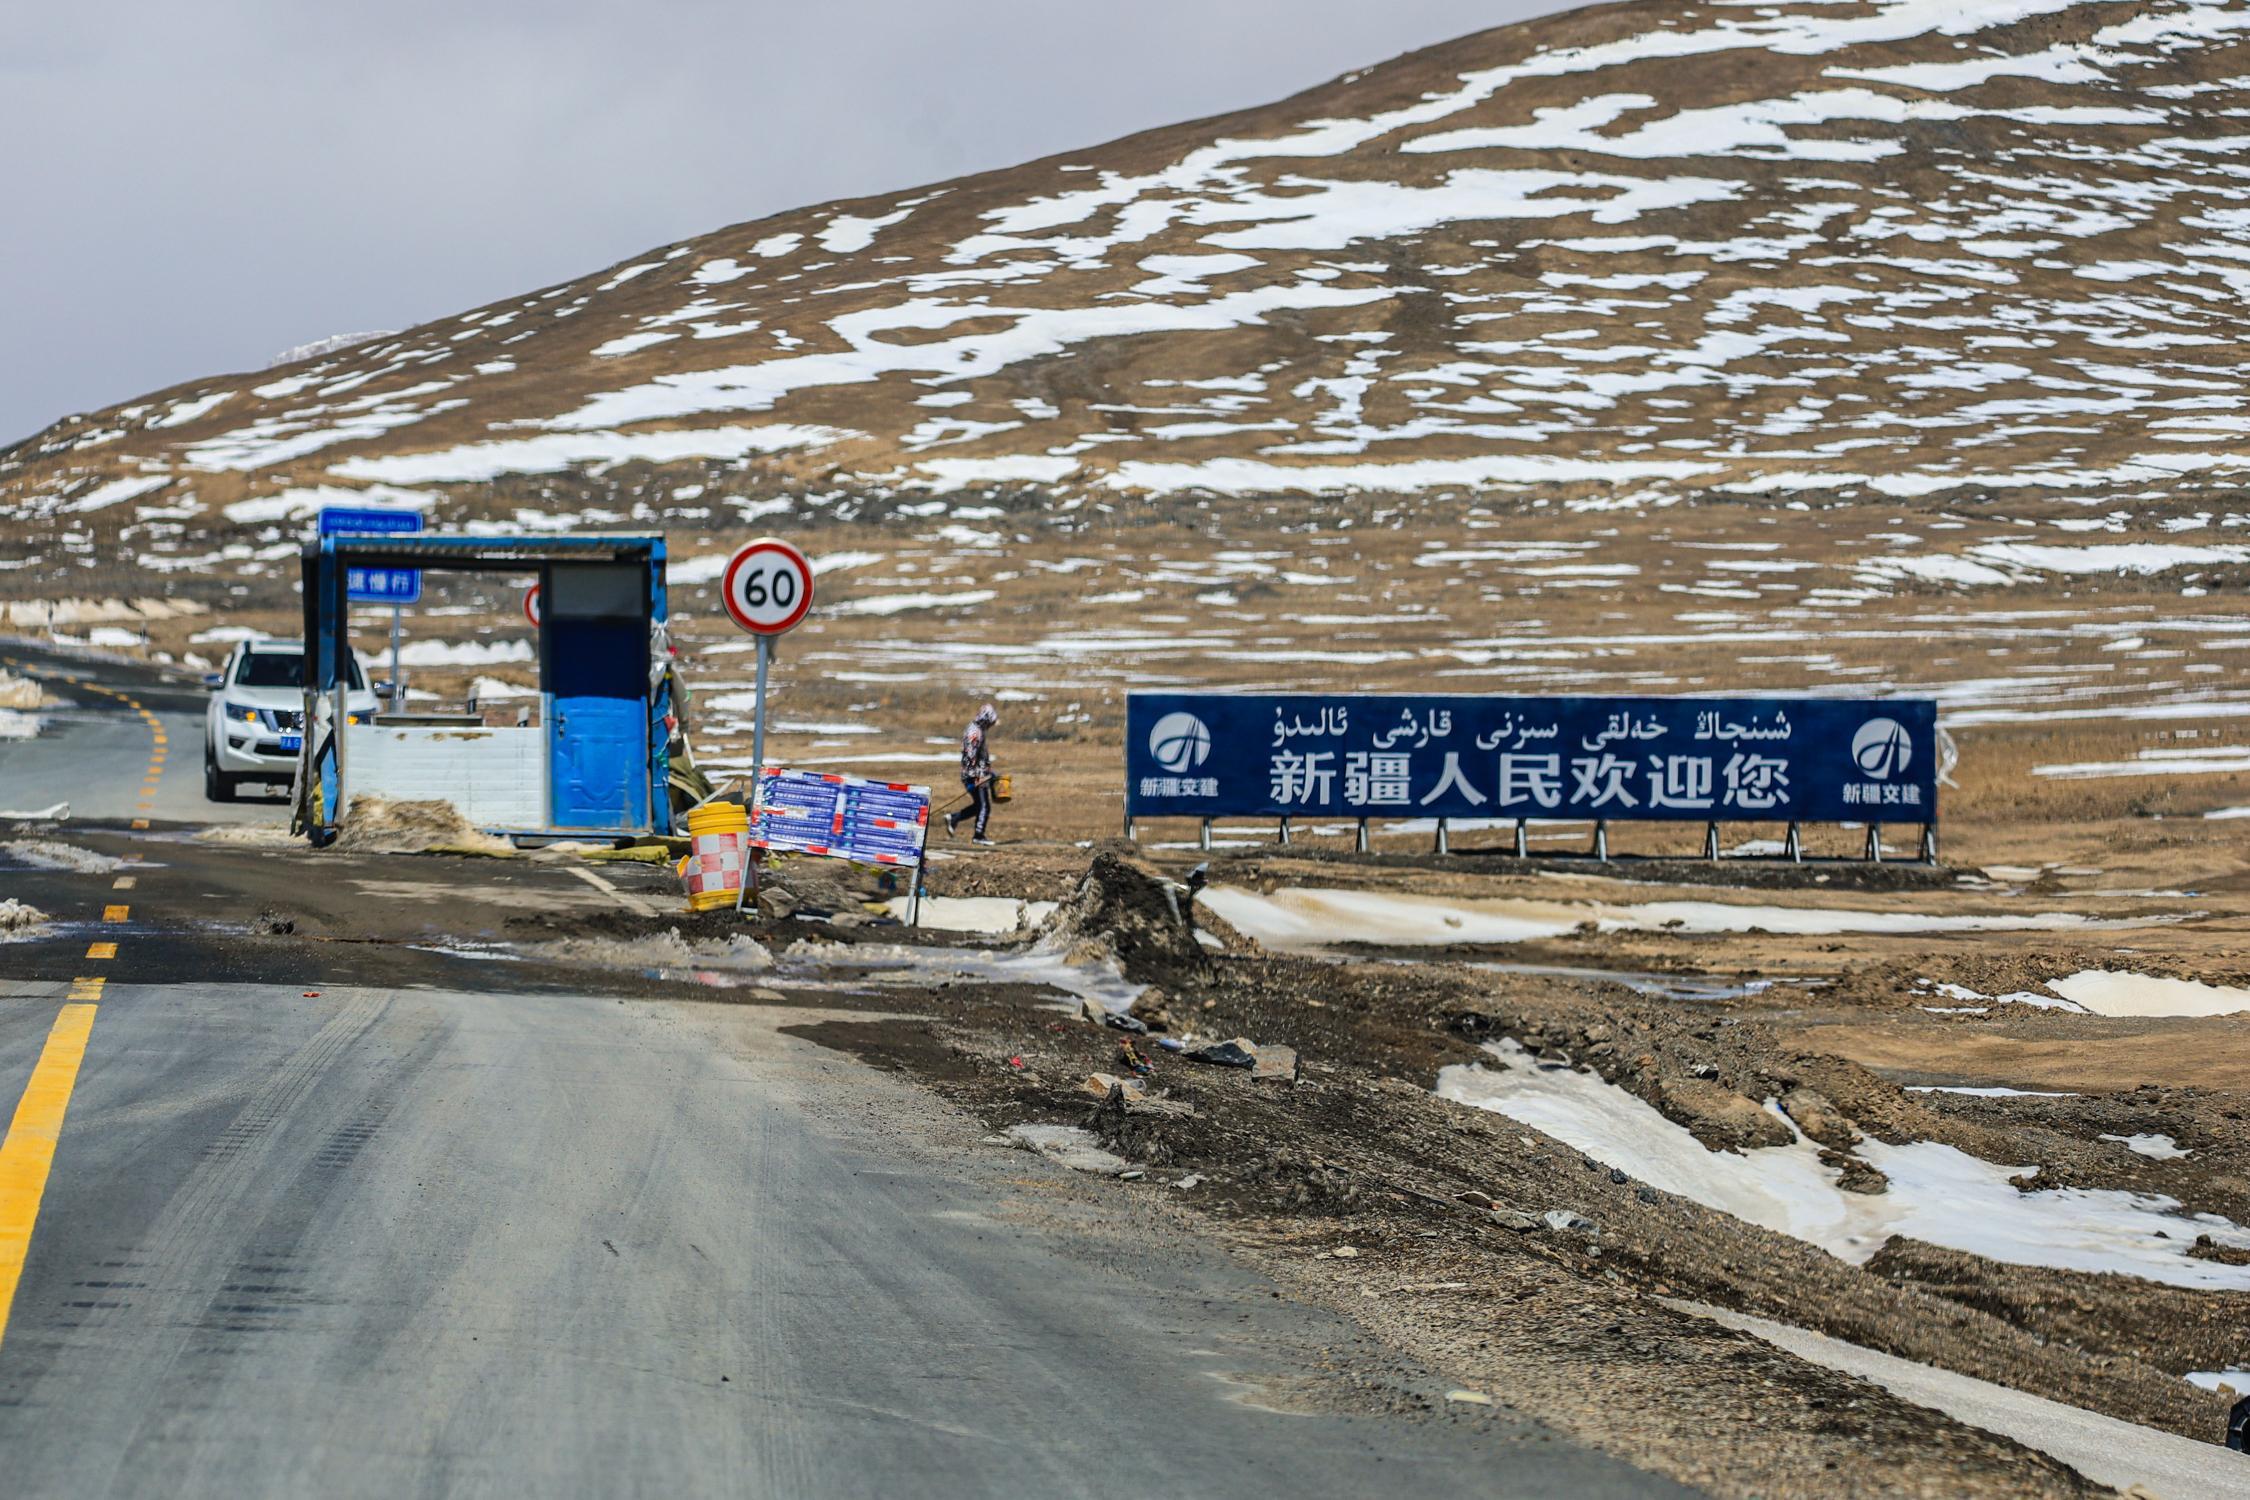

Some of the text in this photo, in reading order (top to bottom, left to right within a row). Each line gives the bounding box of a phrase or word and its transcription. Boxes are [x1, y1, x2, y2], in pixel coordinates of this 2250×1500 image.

[745, 569, 795, 608] 60
[1140, 777, 1219, 798] 新疆交建
[1269, 749, 1791, 808] 新疆人民欢迎您
[1842, 783, 1922, 805] 新疆交建
